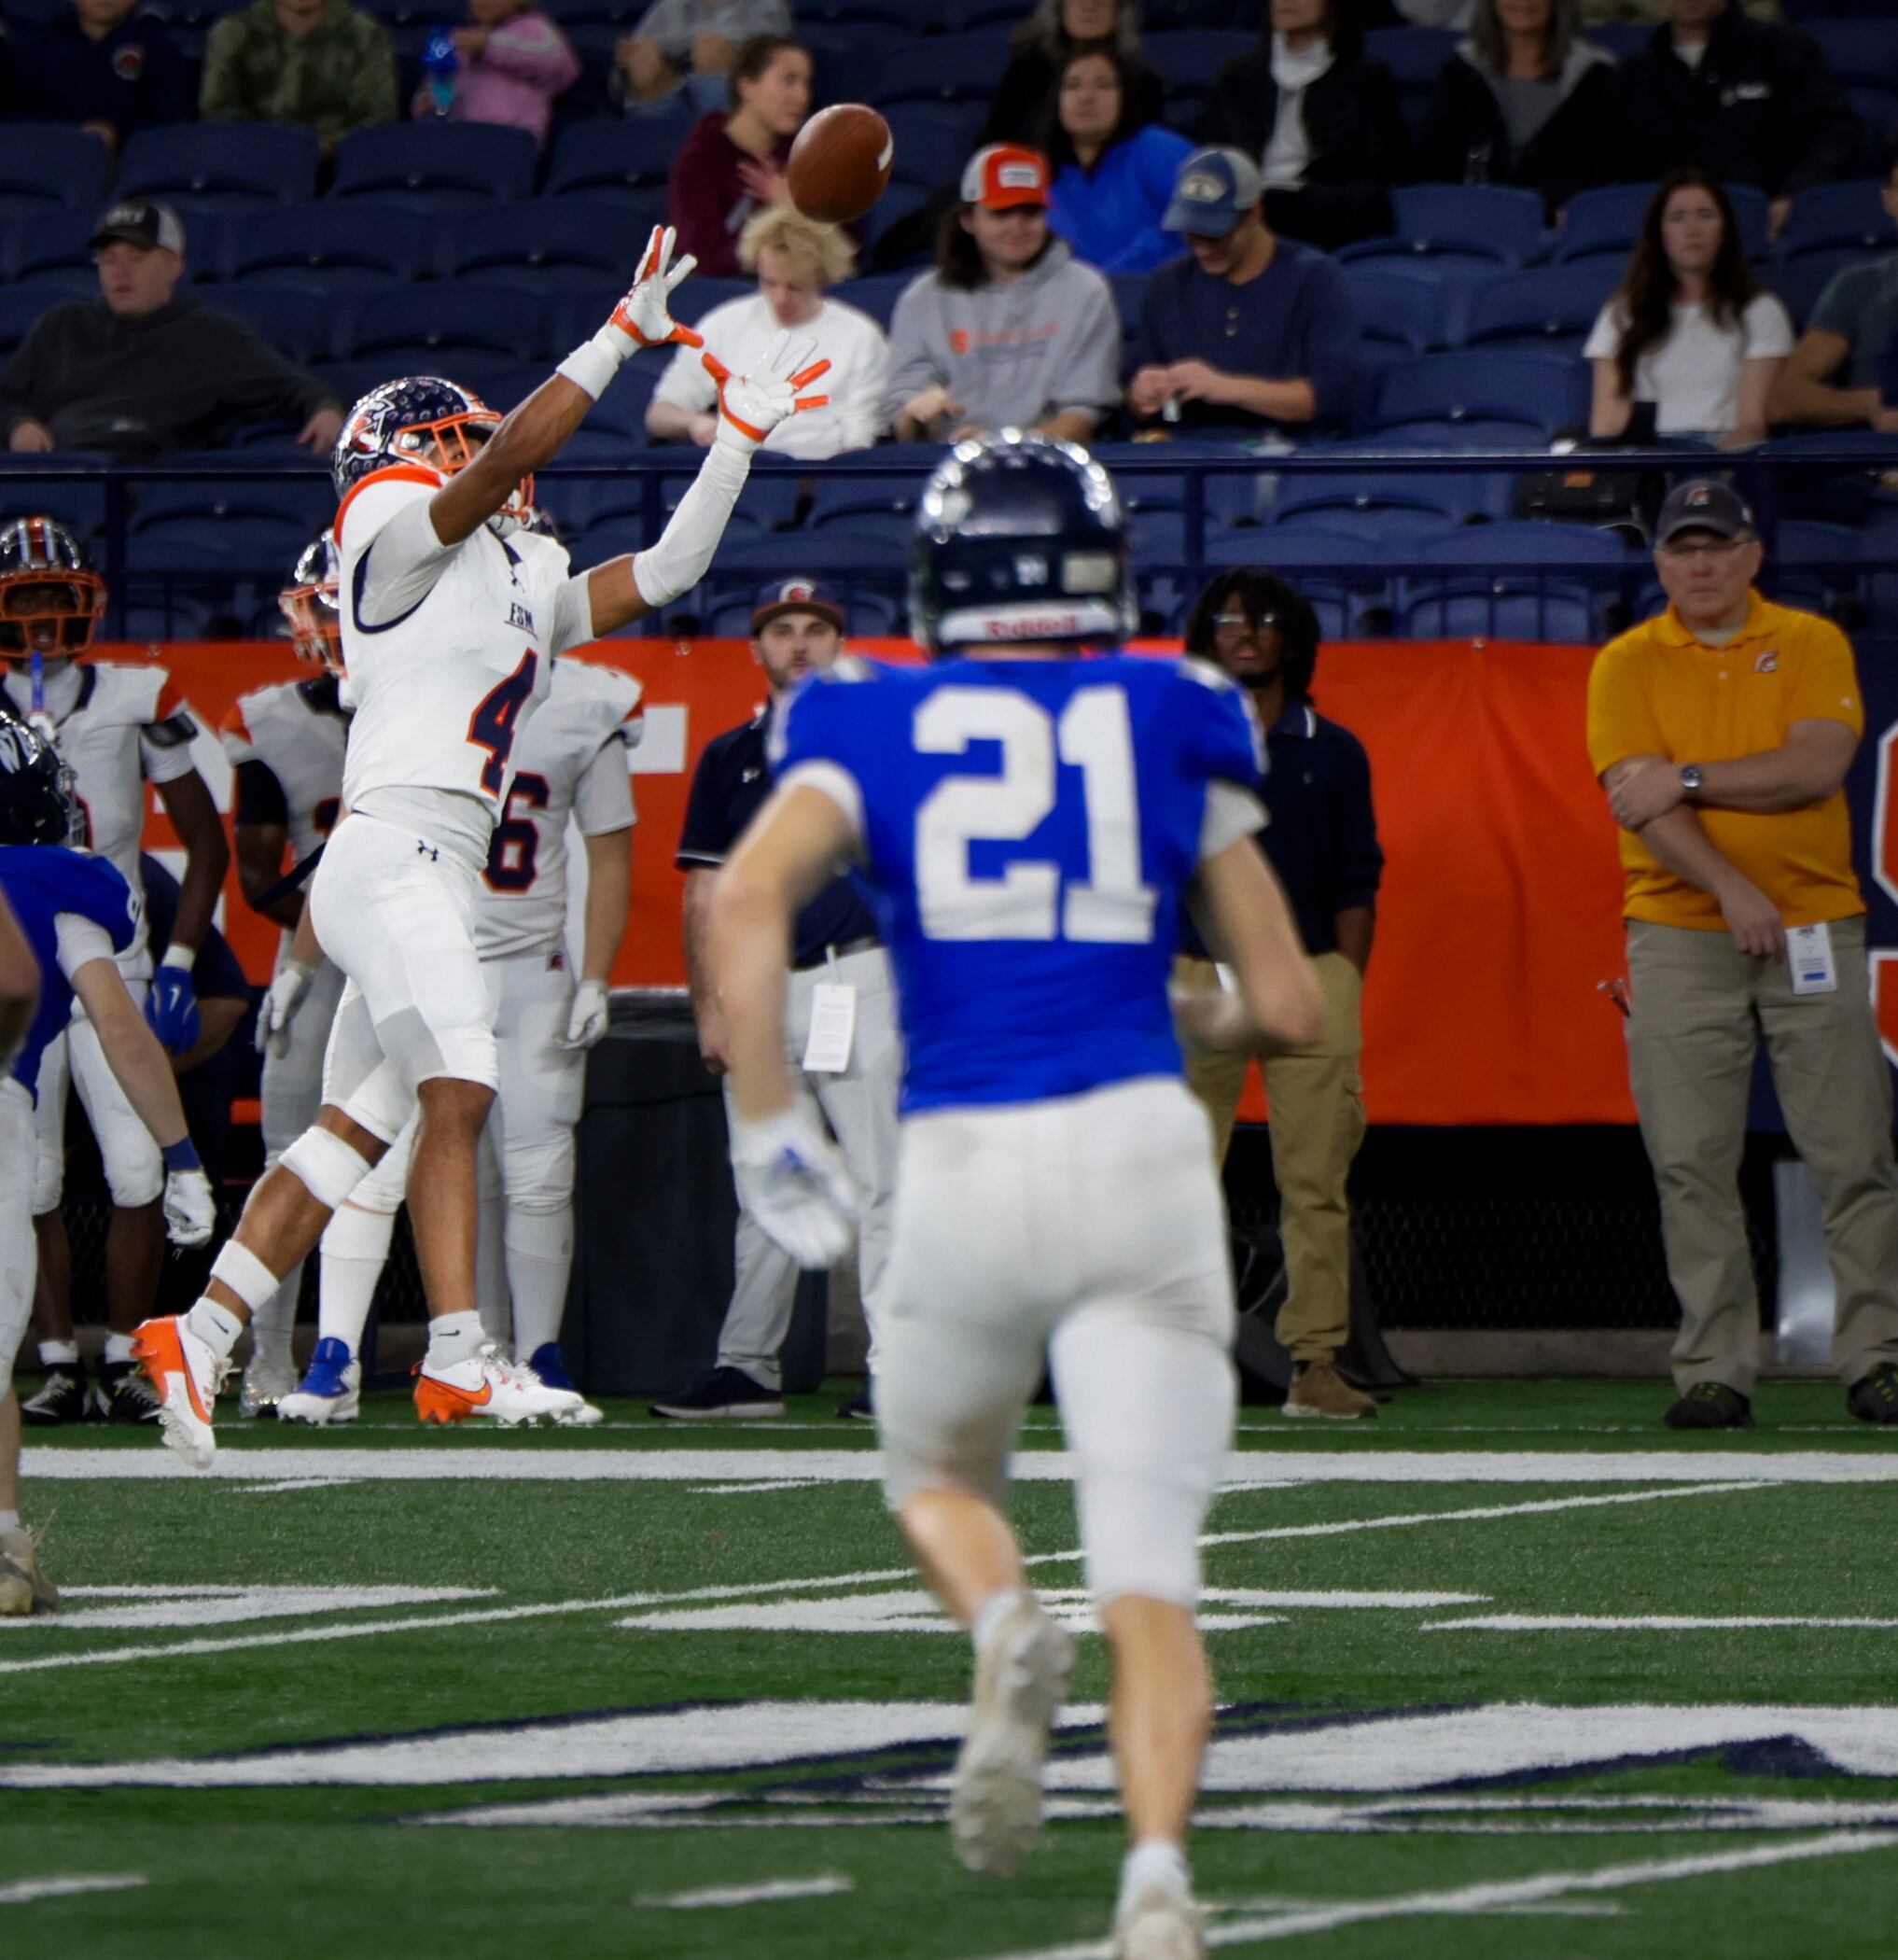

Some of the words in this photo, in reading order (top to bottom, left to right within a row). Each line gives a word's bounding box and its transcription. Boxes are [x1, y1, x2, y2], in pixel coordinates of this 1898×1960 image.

[509, 602, 536, 632] ESM
[467, 647, 538, 800] 4
[913, 684, 1158, 943] 21
